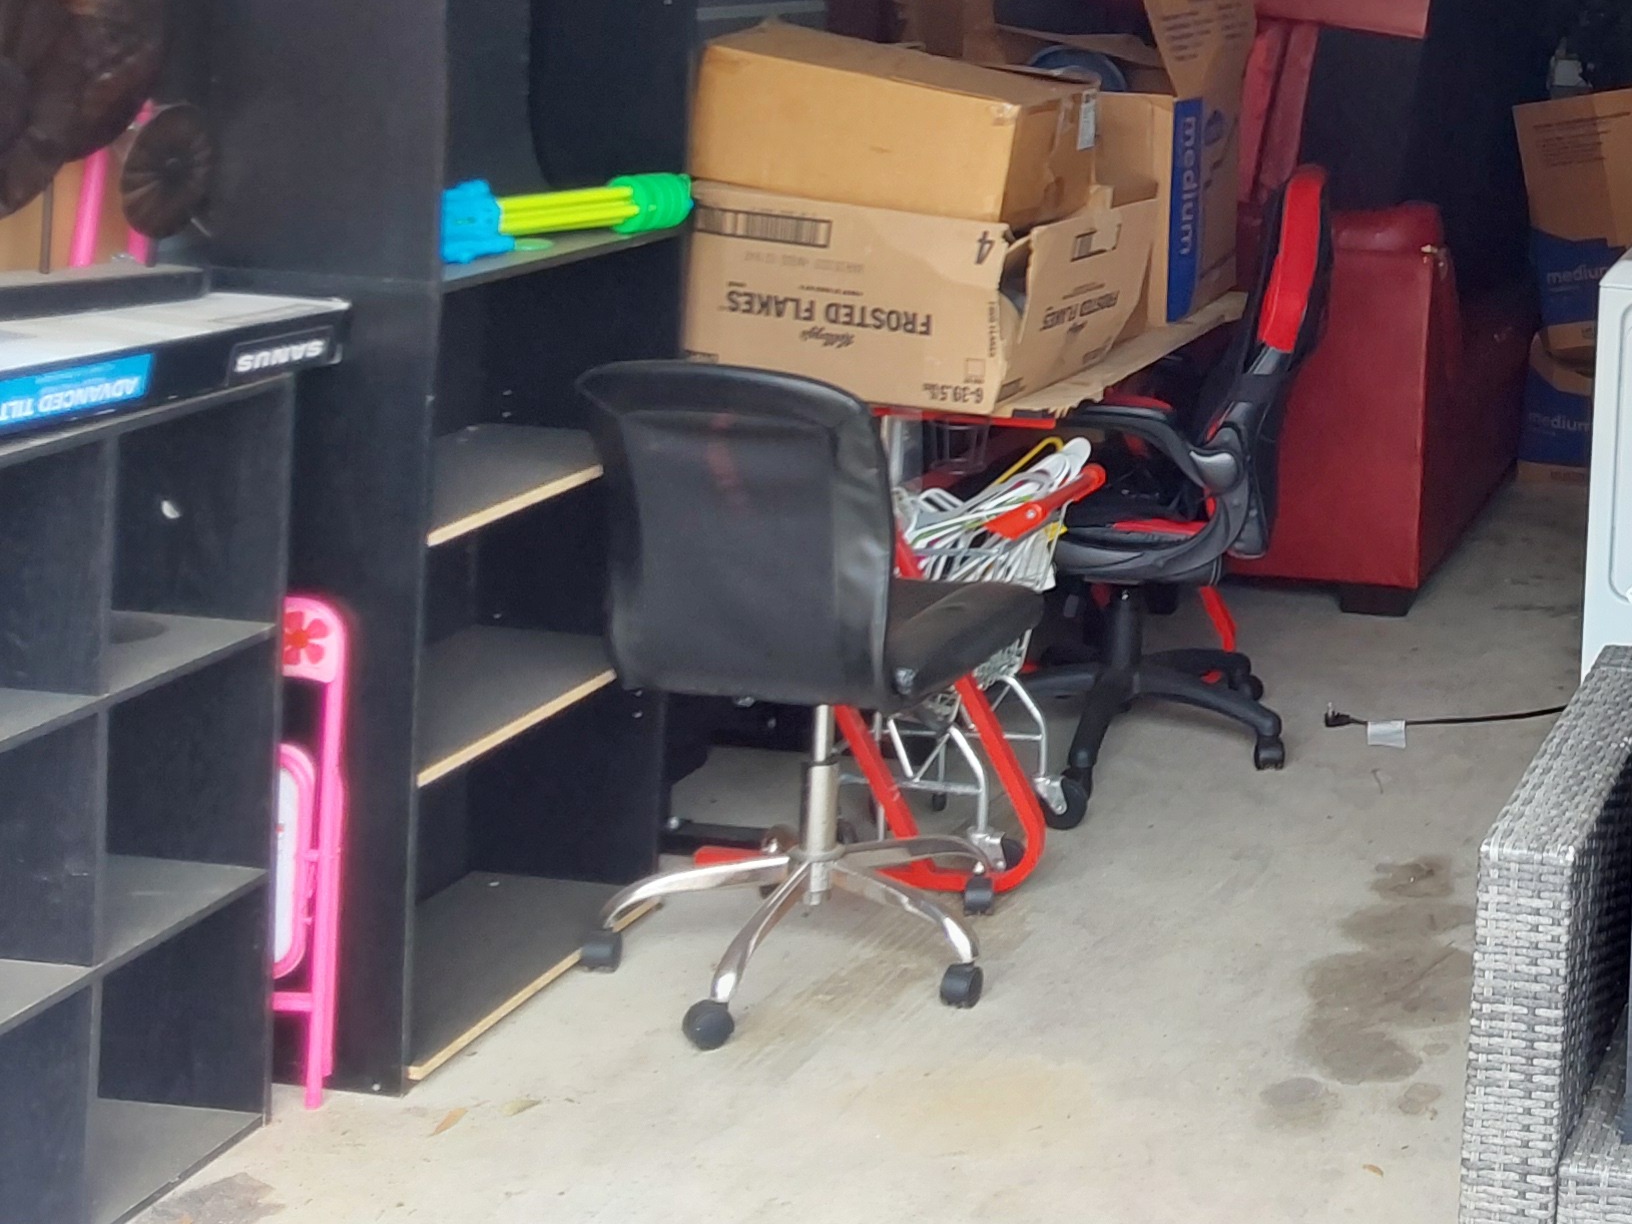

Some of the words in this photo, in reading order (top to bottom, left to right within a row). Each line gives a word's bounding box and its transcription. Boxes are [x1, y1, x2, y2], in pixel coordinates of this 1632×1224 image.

[1179, 116, 1197, 255] medium
[975, 230, 995, 265] 4
[726, 289, 816, 322] FLAKES
[825, 302, 933, 336] FROSTED
[235, 340, 325, 372] SANUS
[37, 377, 139, 413] ADVANCED
